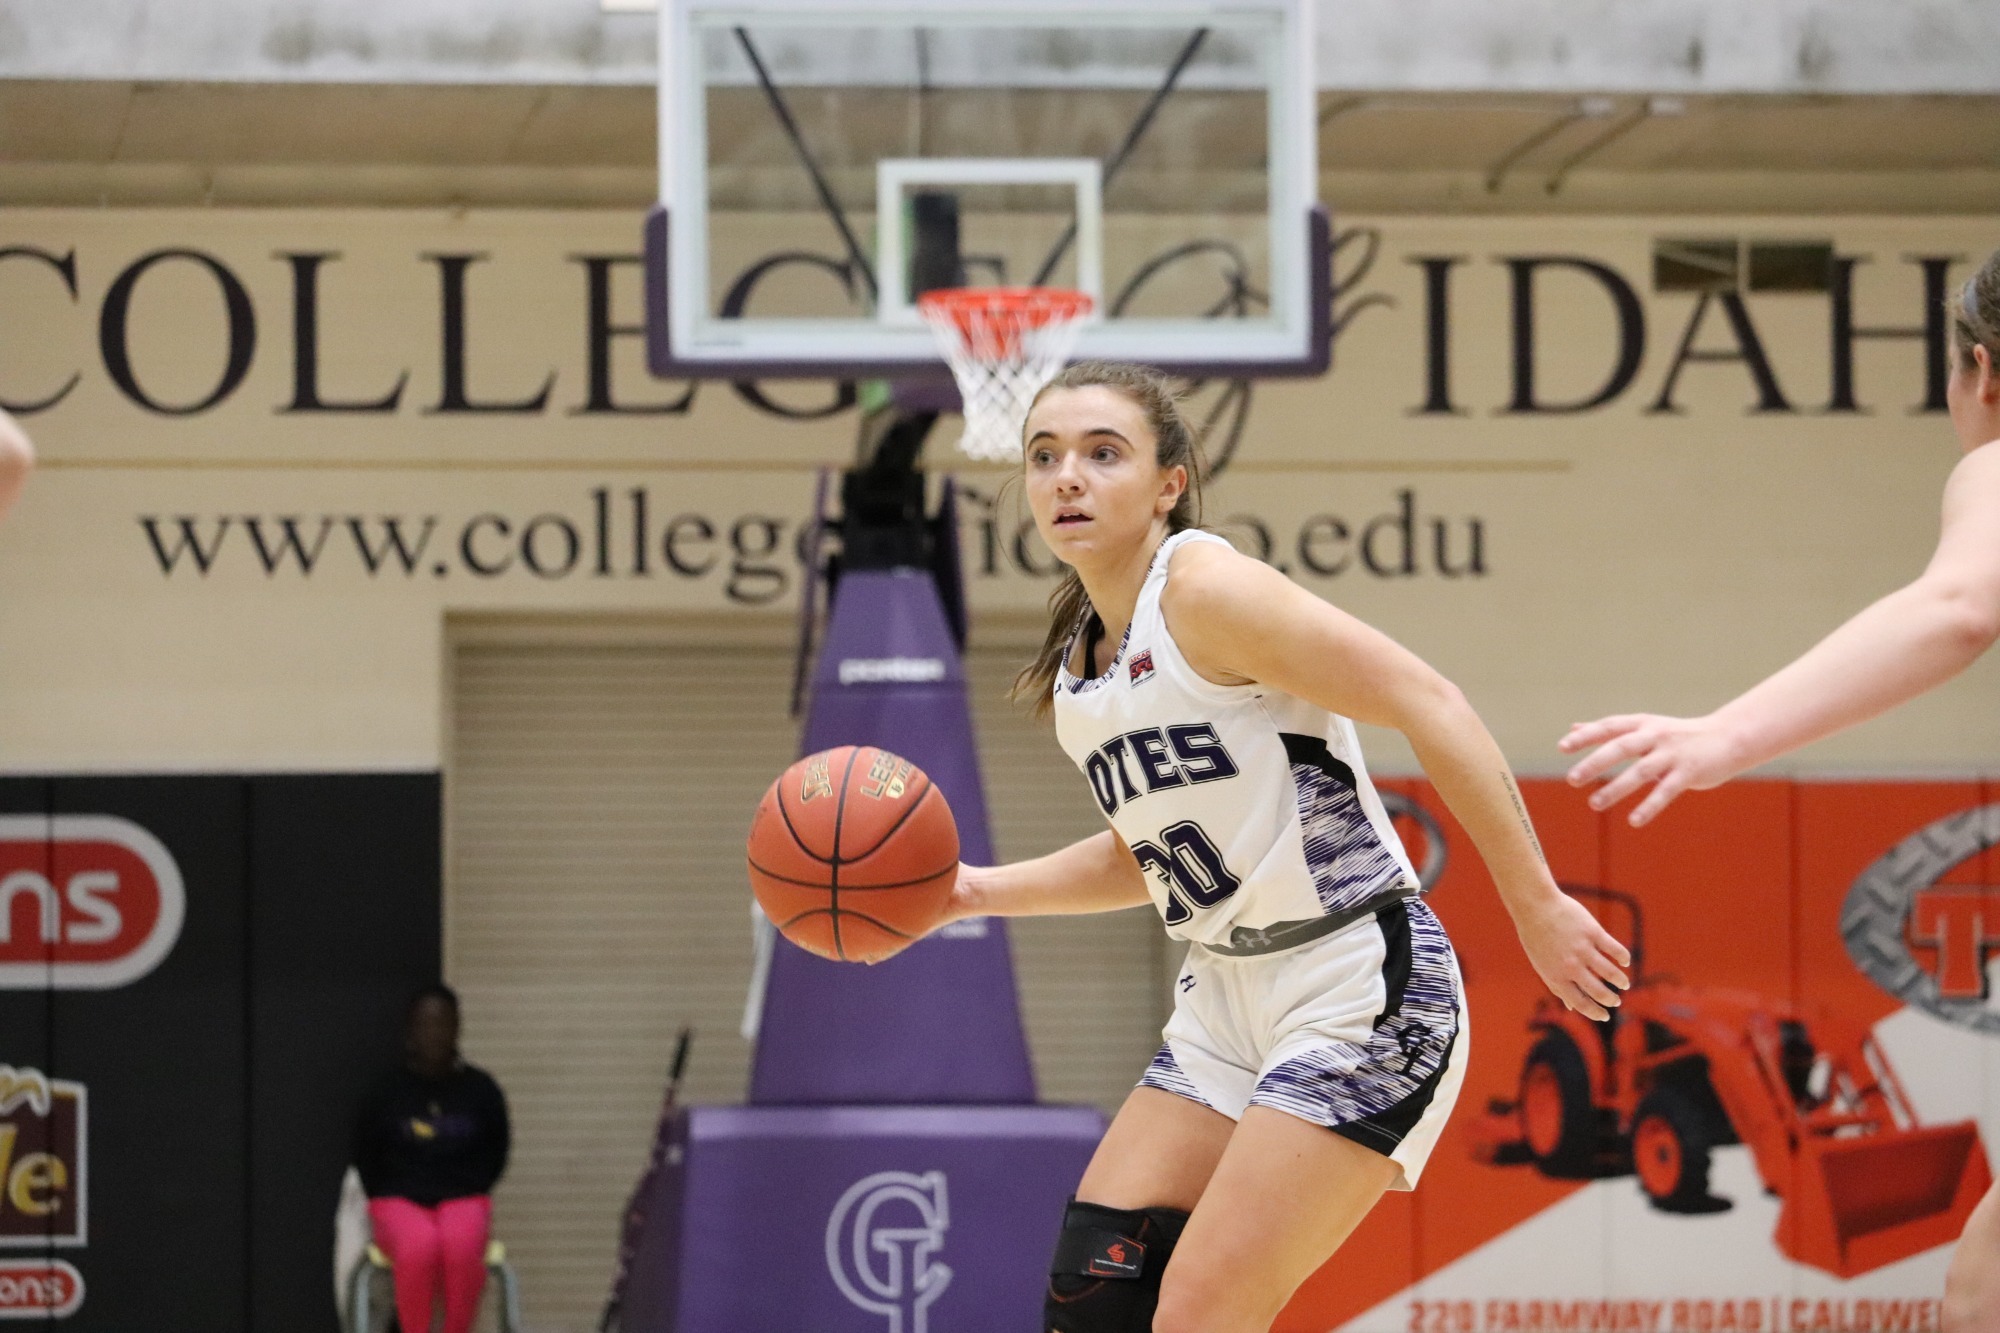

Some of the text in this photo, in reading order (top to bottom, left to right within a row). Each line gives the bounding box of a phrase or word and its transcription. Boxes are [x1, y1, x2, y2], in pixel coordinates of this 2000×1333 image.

[0, 246, 1006, 419] COLLEG
[1084, 722, 1239, 818] OTES
[1486, 1300, 1663, 1332] FARMWAY
[1671, 1300, 1762, 1332] ROAD
[1789, 1300, 1942, 1332] CALDWE
